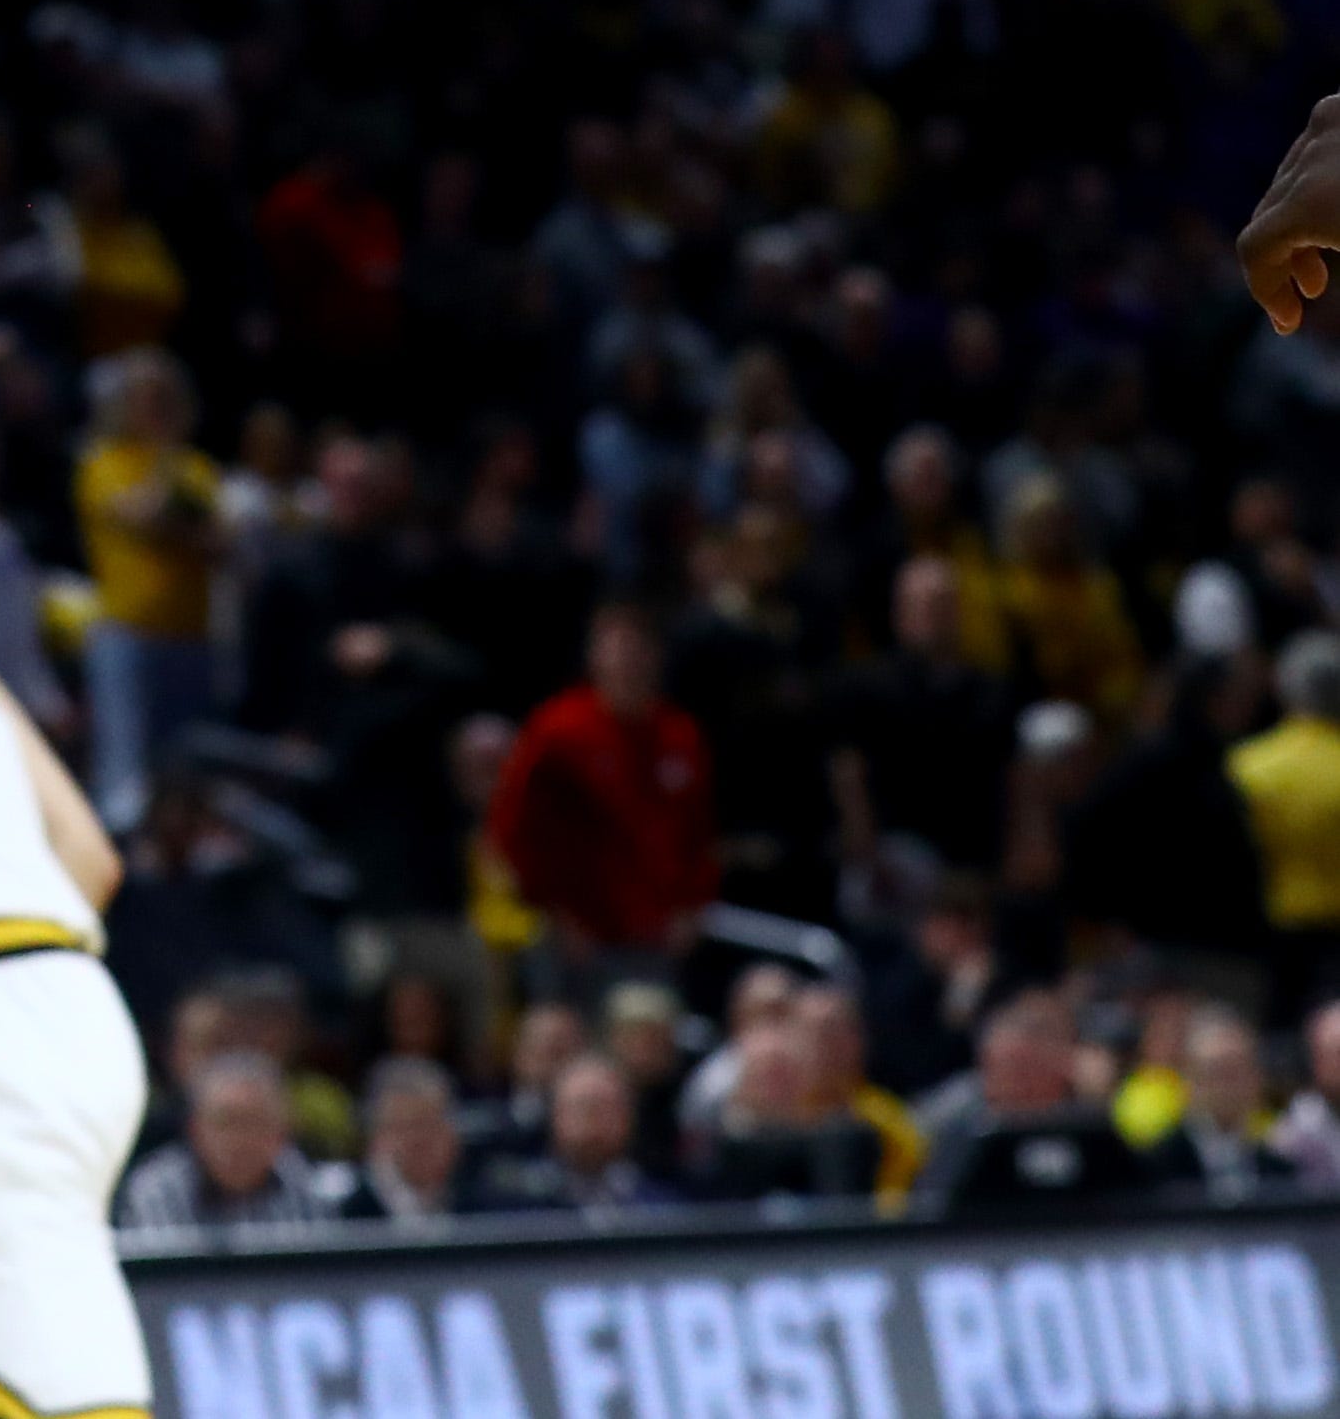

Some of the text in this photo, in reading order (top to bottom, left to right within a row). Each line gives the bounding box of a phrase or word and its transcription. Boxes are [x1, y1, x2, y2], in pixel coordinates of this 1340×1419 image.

[167, 1248, 1329, 1419] NCAA FIRST ROUND
